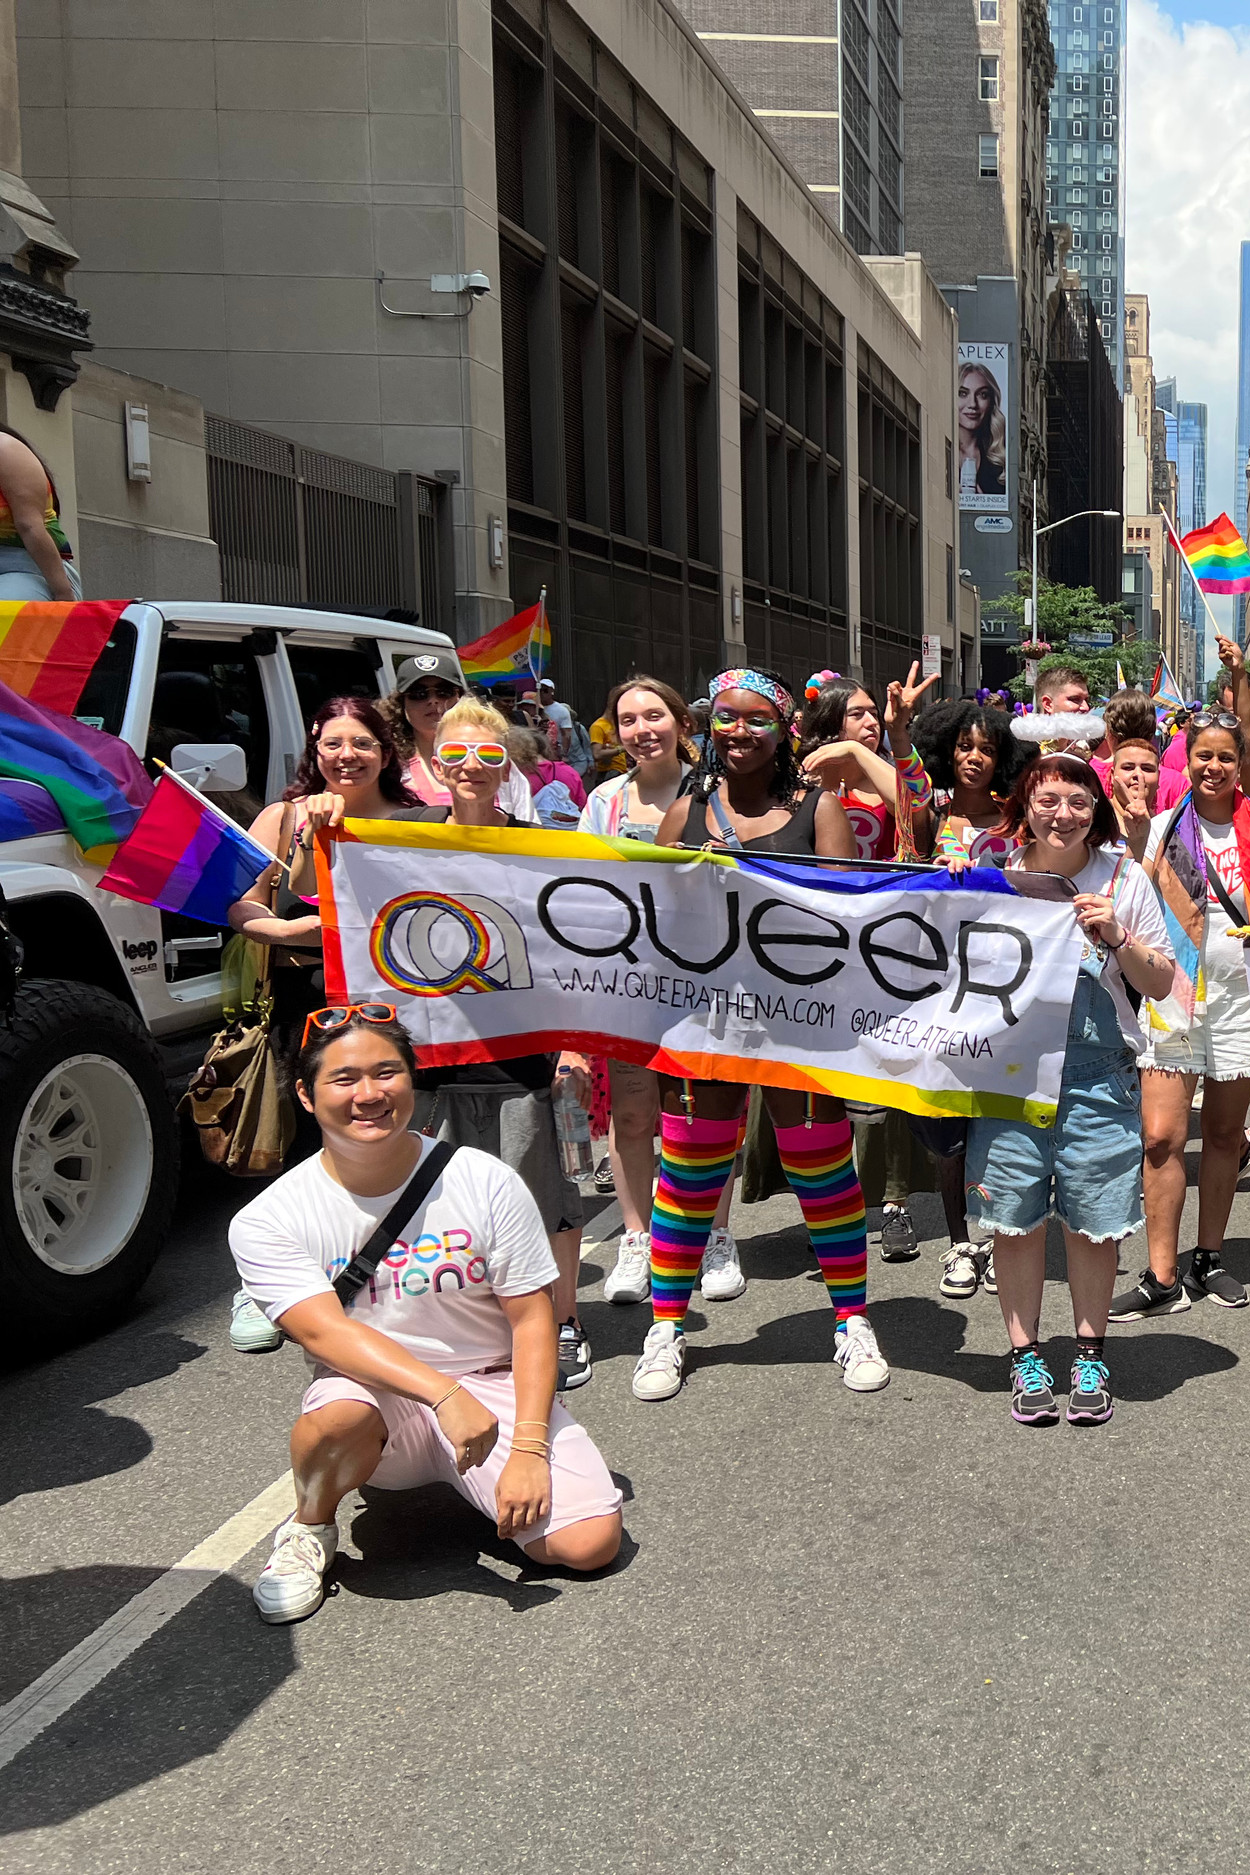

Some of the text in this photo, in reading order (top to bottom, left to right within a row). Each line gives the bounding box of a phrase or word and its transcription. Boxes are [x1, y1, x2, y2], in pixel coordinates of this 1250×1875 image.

[958, 345, 1005, 359] APLEX
[552, 967, 993, 1059] WWW.QUEERATHENA.COM @QUEER_ATHENA
